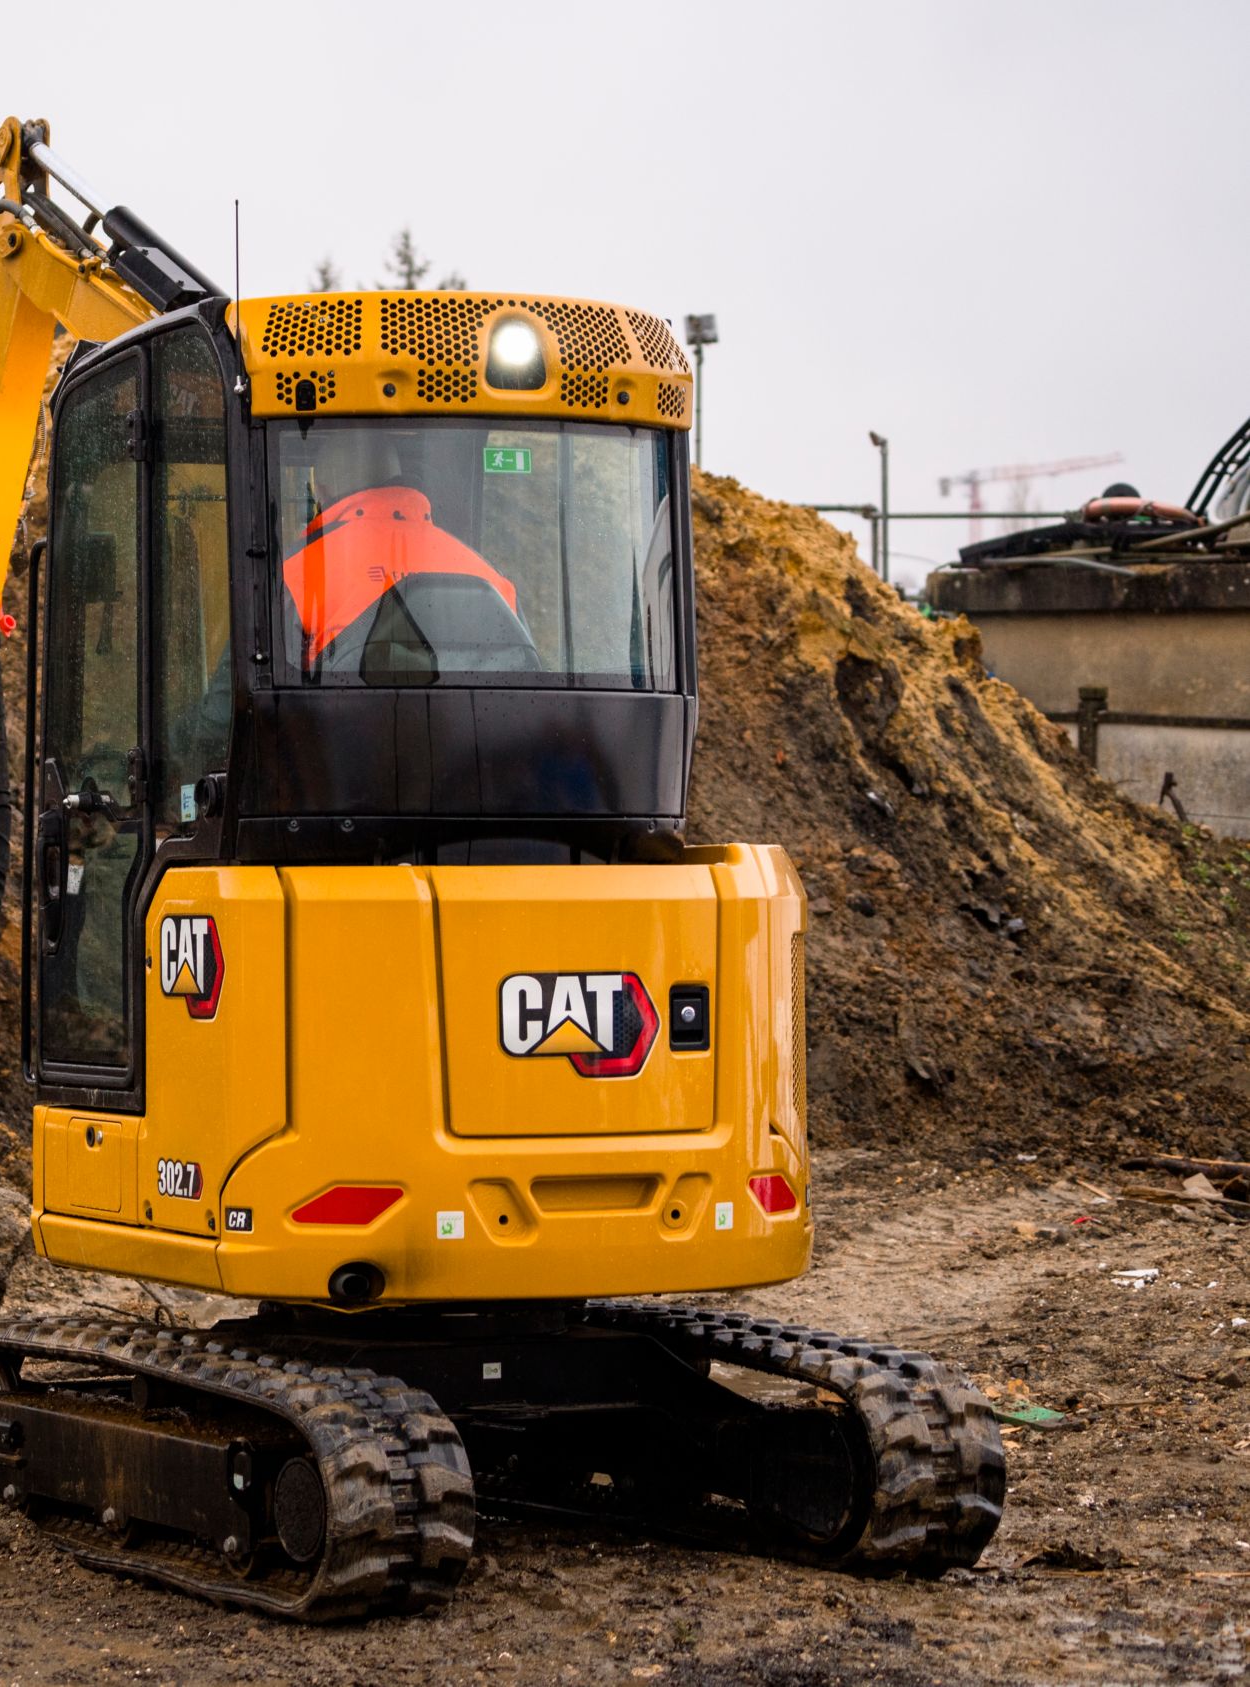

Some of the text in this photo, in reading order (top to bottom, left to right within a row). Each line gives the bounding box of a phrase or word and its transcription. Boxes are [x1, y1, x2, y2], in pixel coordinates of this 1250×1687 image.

[161, 917, 208, 994] CAT
[502, 975, 623, 1054] CAT
[158, 1159, 195, 1197] 302.7
[228, 1211, 246, 1228] CR
